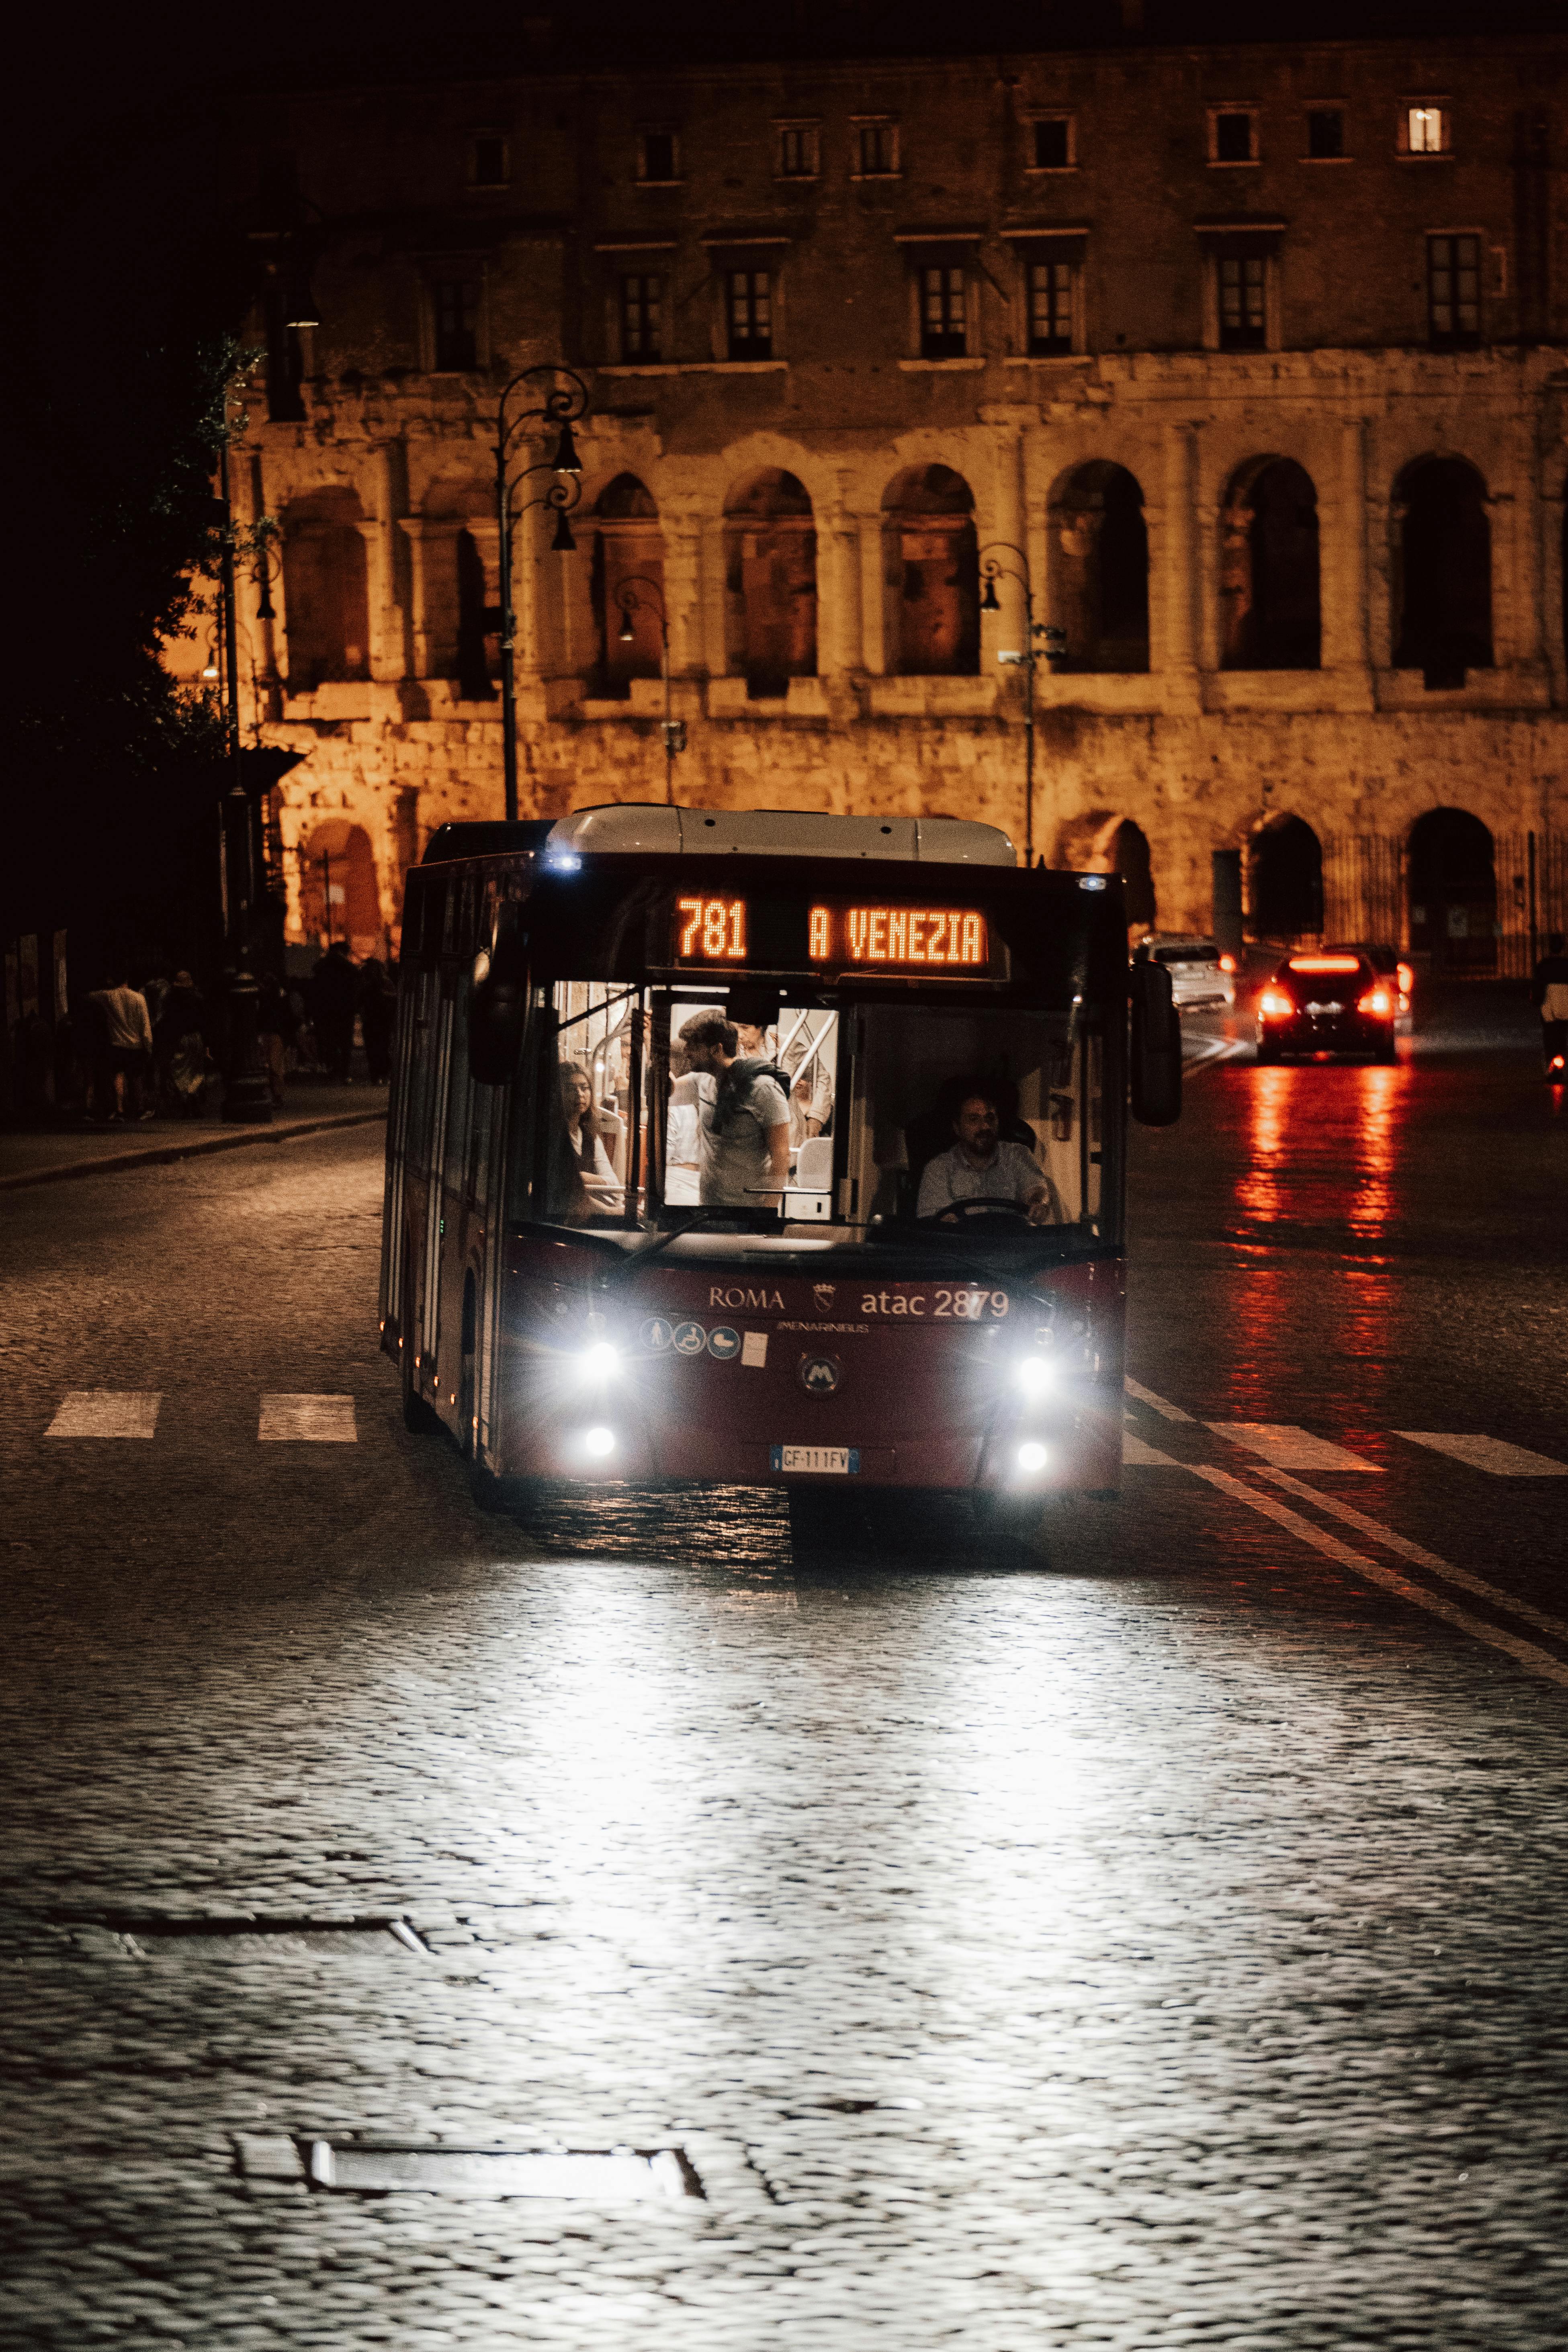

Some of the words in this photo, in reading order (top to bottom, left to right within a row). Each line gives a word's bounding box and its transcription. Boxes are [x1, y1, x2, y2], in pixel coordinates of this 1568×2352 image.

[679, 900, 746, 956] 781
[810, 909, 829, 958] A
[850, 910, 980, 961] VENEZIA
[710, 1287, 785, 1309] ROMA
[861, 1292, 925, 1315] atac
[933, 1290, 1009, 1318] 2879
